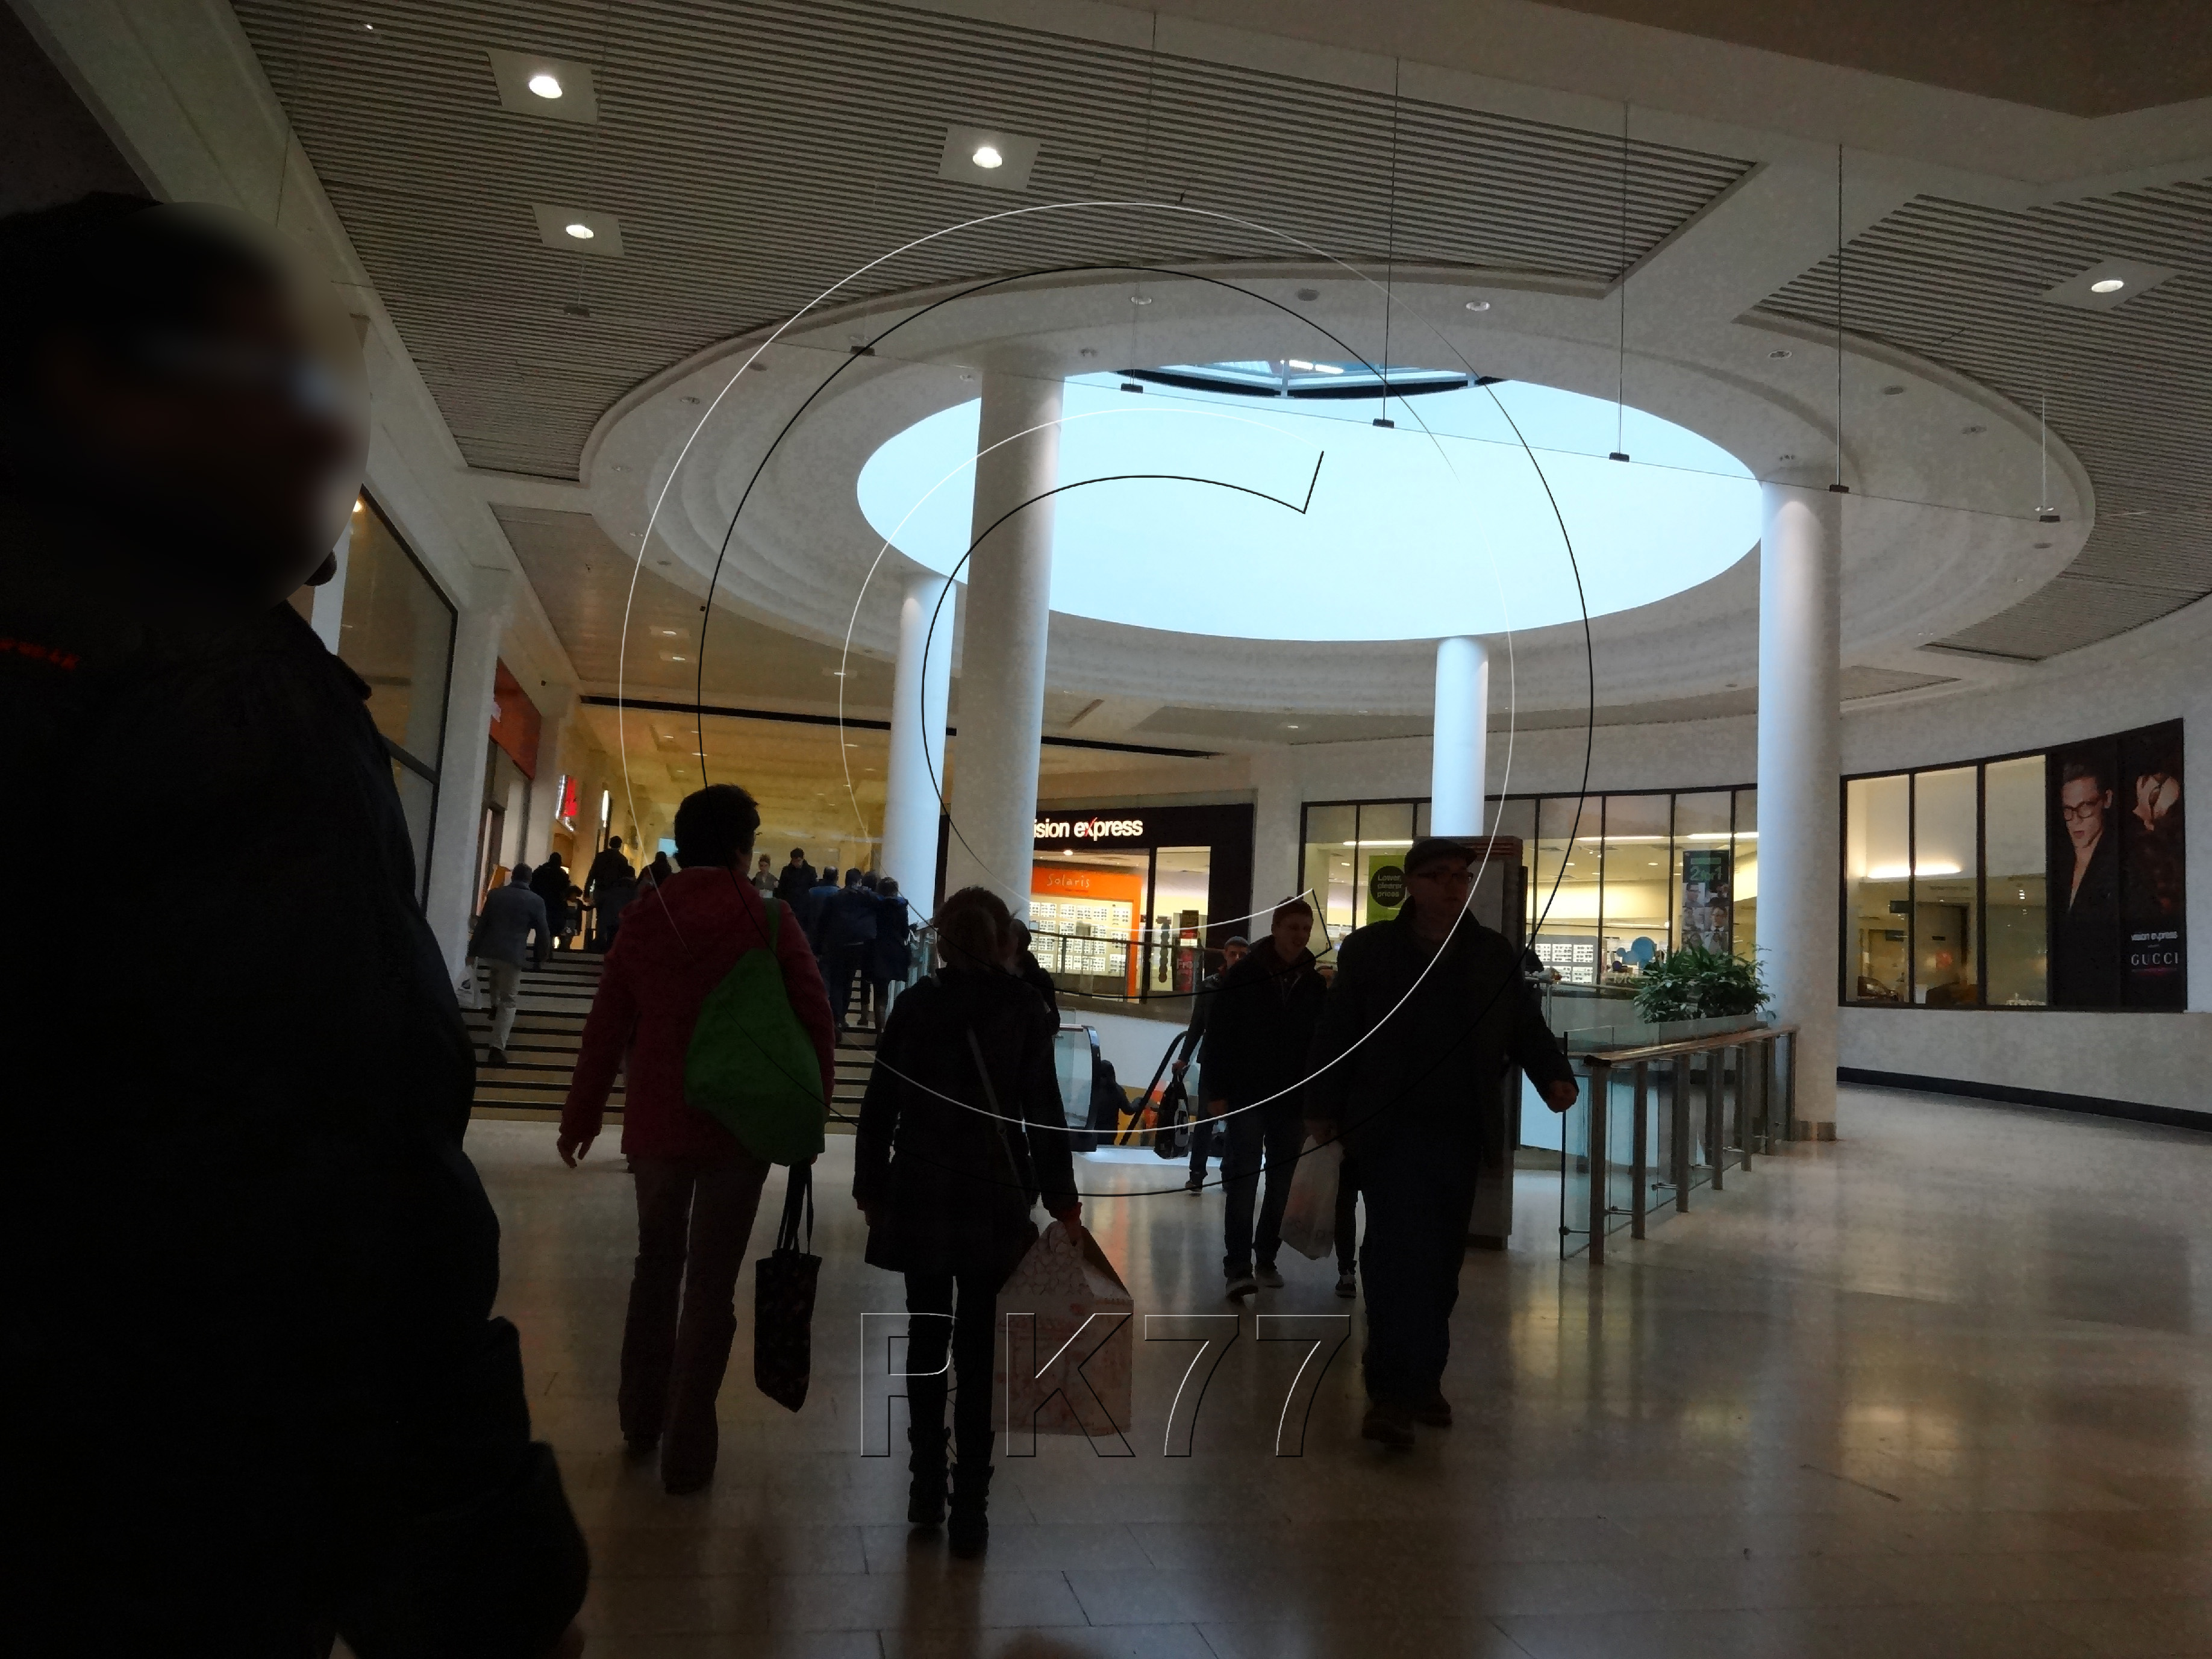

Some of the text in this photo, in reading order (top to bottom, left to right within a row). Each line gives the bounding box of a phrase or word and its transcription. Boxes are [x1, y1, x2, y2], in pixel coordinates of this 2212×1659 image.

[1034, 817, 1143, 842] ision express
[1046, 874, 1090, 888] Solaris
[2131, 952, 2179, 966] GUCCI
